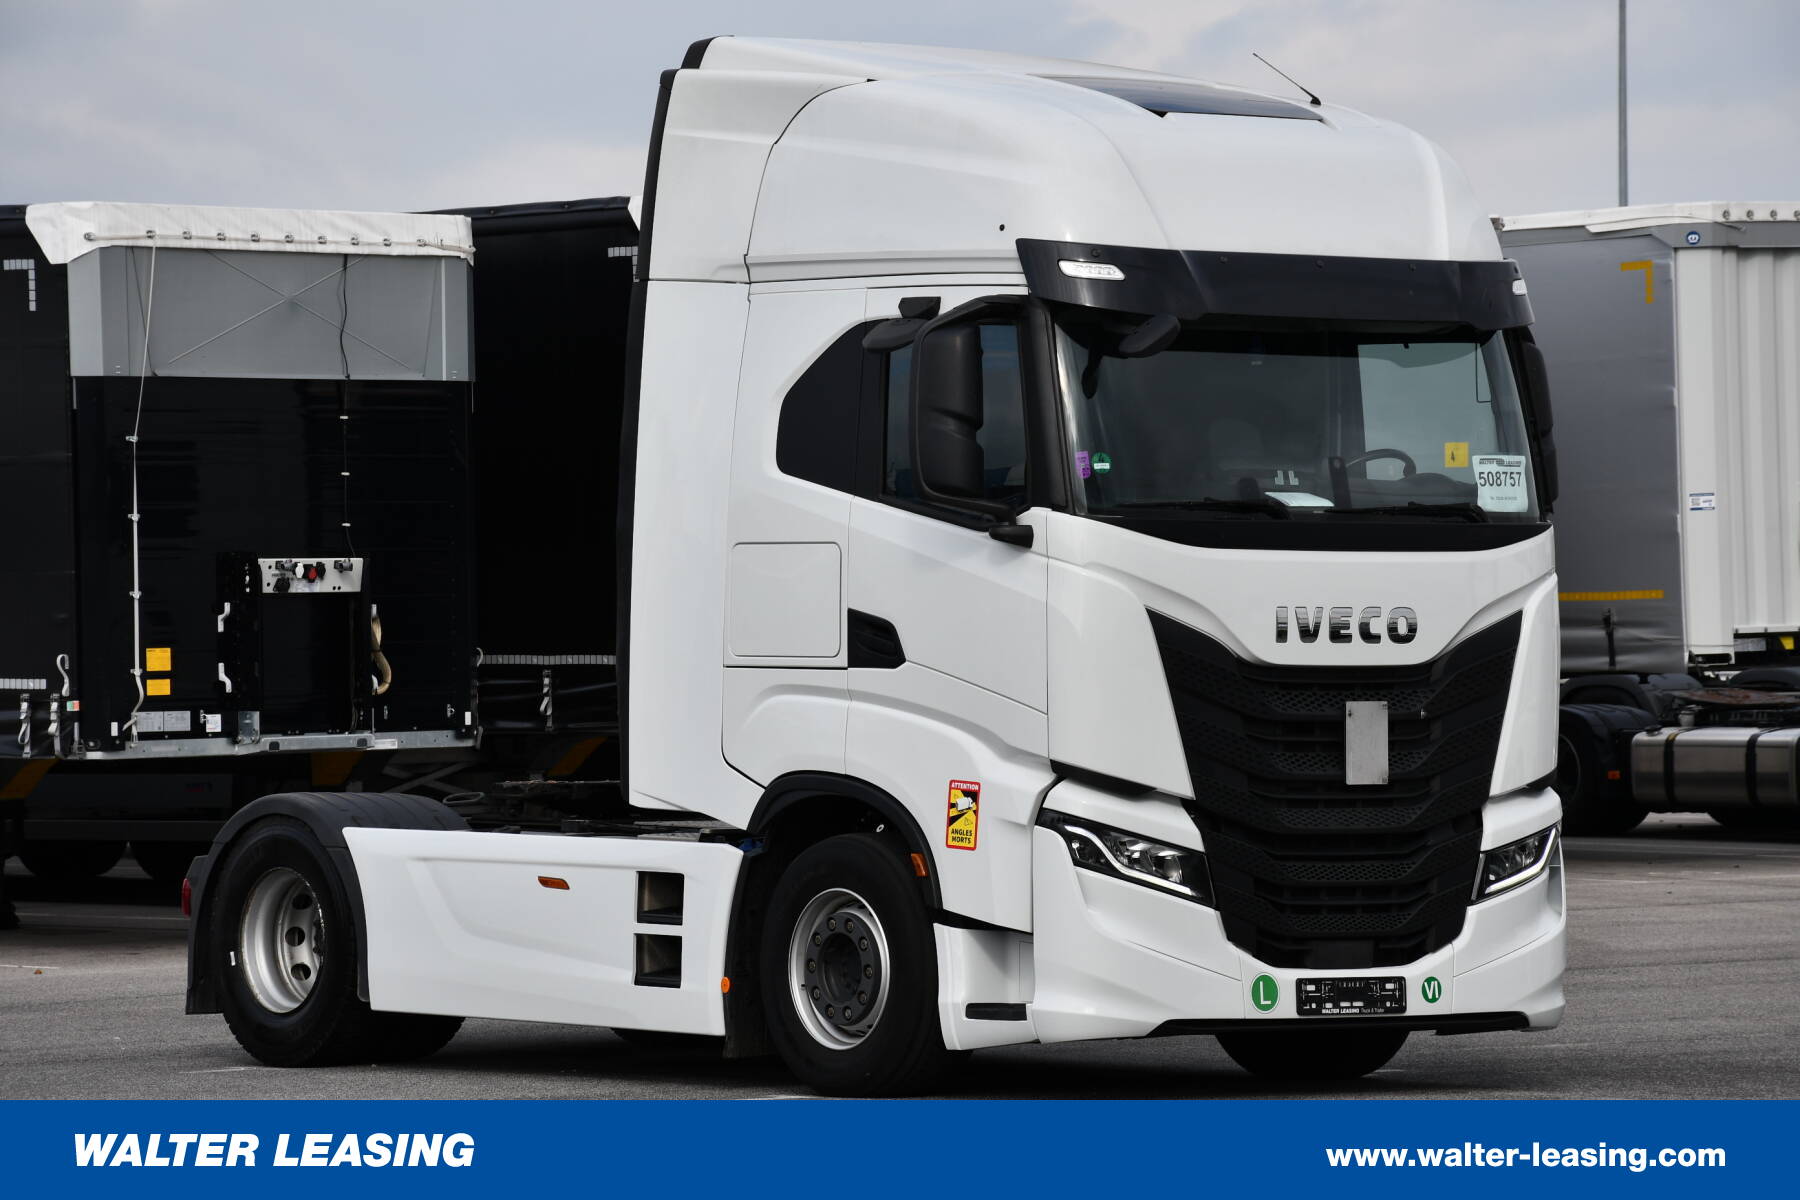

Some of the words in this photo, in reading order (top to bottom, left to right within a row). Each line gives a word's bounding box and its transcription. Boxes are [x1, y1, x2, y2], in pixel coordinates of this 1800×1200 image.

[1478, 471, 1522, 487] 508757
[1276, 606, 1418, 644] IVECO
[951, 782, 979, 791] ATTENTION
[951, 828, 973, 837] ANGLES
[951, 835, 972, 844] MORTS
[1260, 980, 1272, 1005] L
